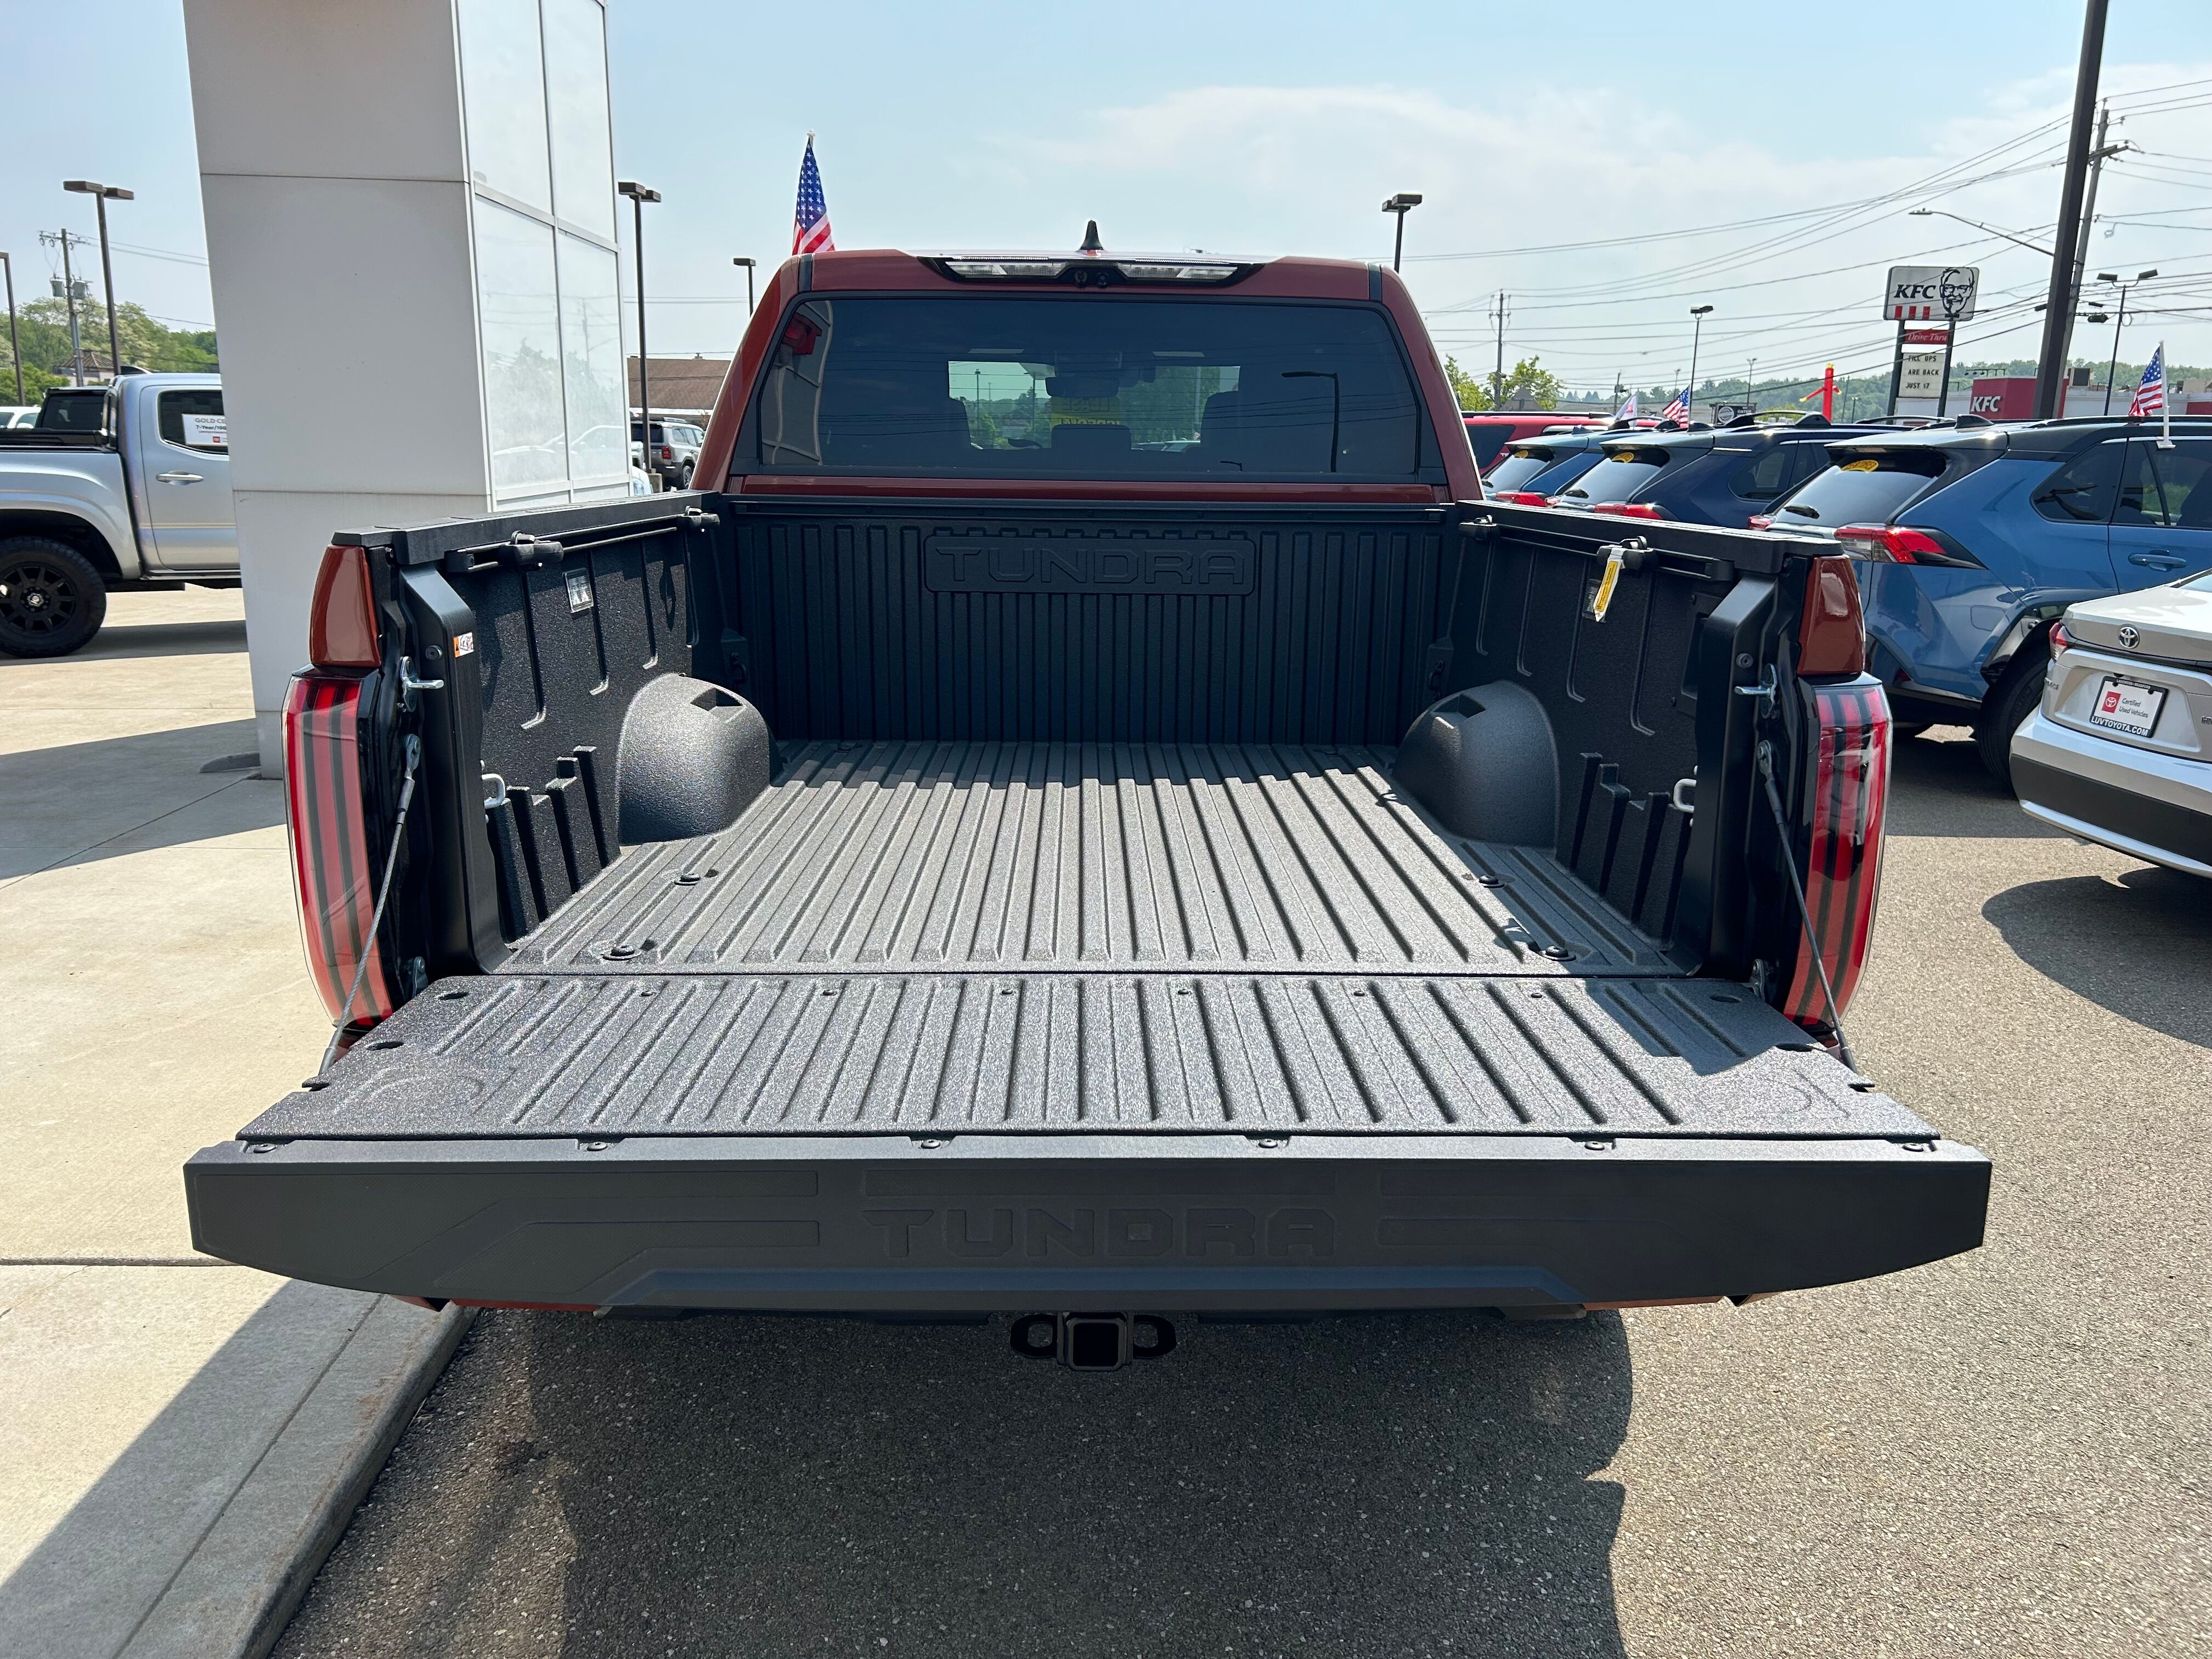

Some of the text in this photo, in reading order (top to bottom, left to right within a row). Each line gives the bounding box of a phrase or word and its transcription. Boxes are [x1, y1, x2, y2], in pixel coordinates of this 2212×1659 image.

[1894, 284, 1936, 298] KFC
[1970, 396, 2001, 412] KFC
[935, 548, 1244, 584] TUNDRA
[2122, 698, 2142, 707] Certified
[2119, 706, 2149, 718] Used Vehicles
[2091, 716, 2149, 736] LUVTOYOTA.COM
[862, 1208, 1335, 1258] TUNDRA
